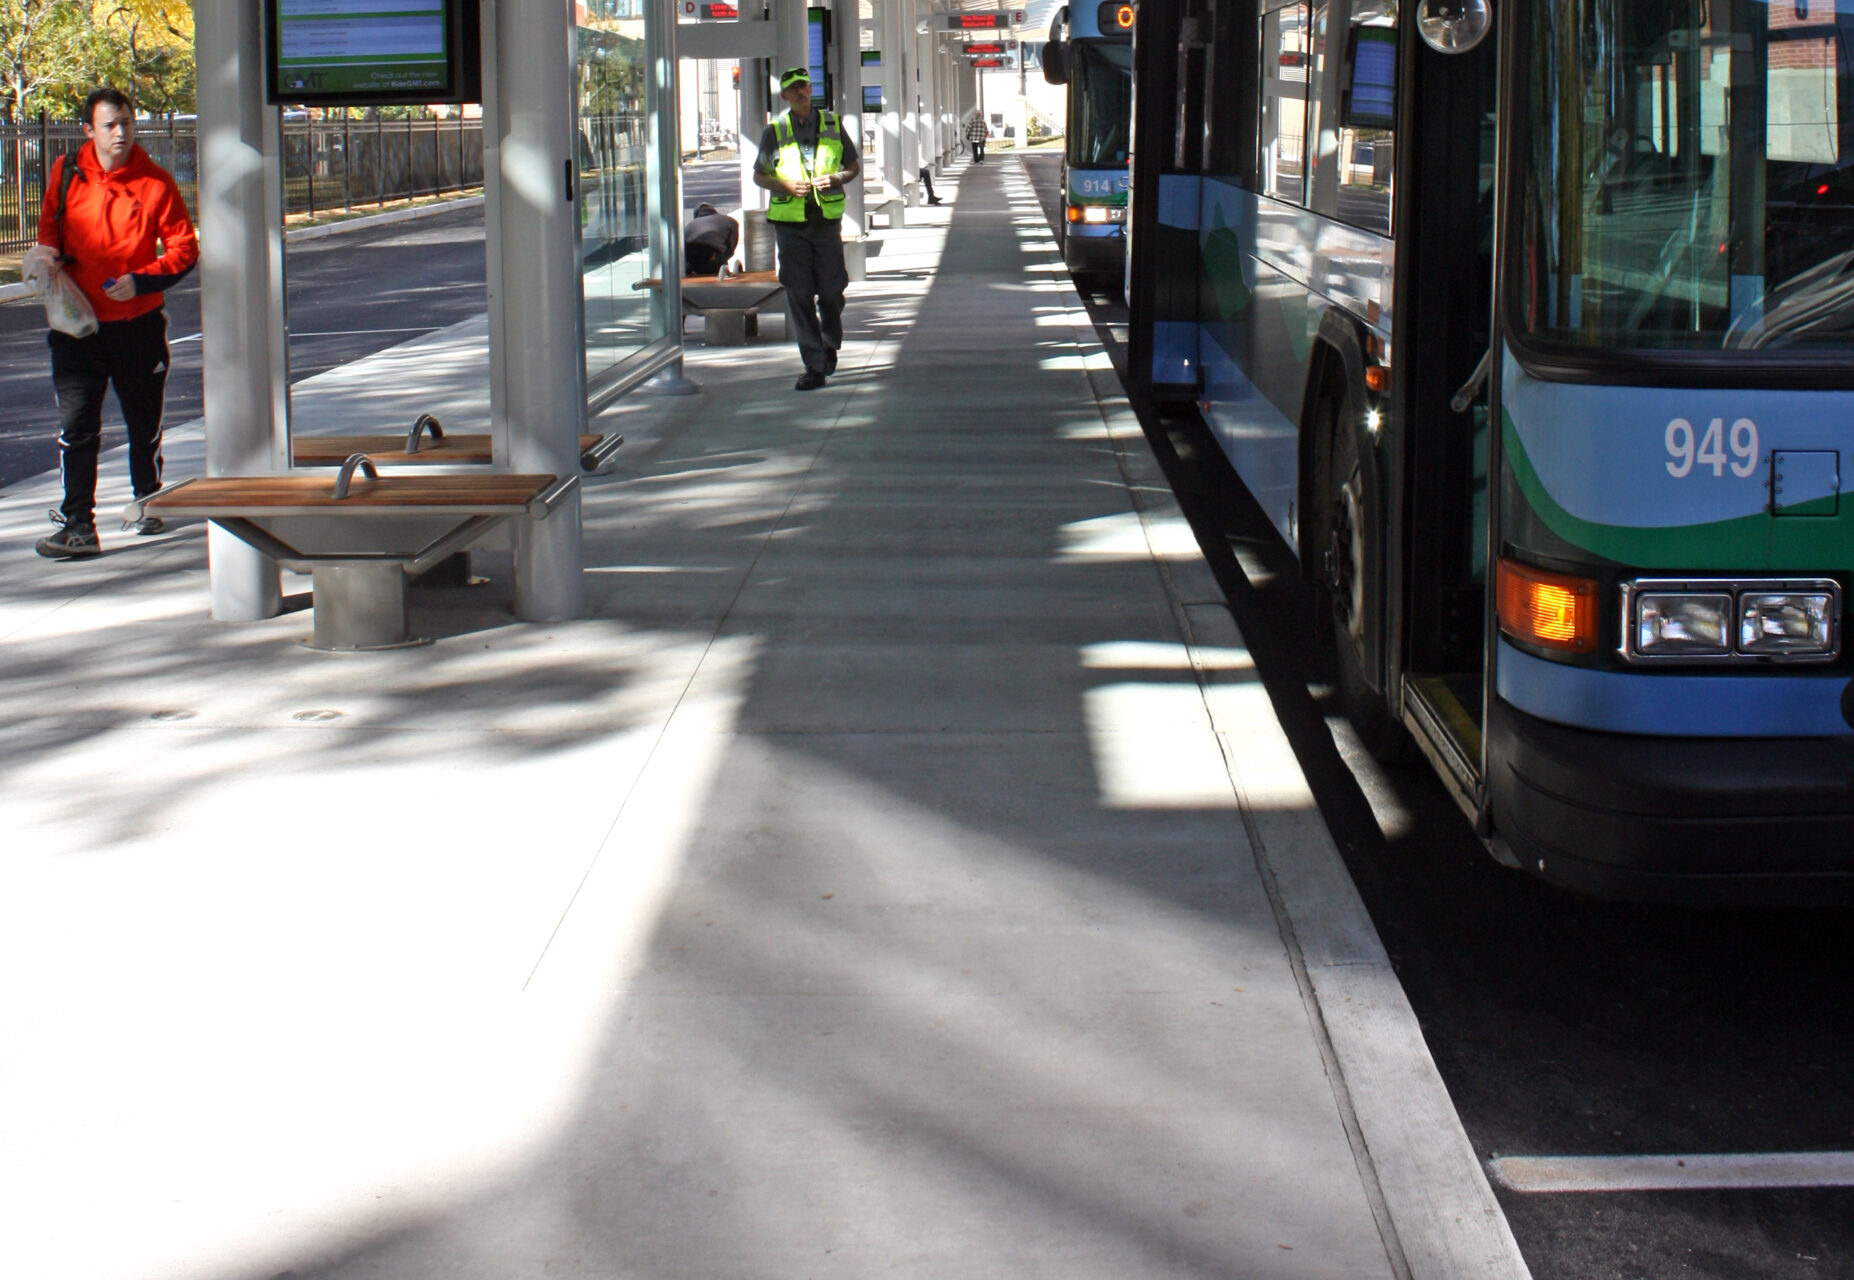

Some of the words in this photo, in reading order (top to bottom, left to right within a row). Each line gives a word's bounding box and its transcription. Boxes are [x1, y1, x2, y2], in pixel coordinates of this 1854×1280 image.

[686, 2, 695, 13] D
[1016, 12, 1022, 22] E
[1009, 41, 1017, 49] G
[1083, 179, 1110, 193] 914
[1664, 417, 1759, 478] 949
